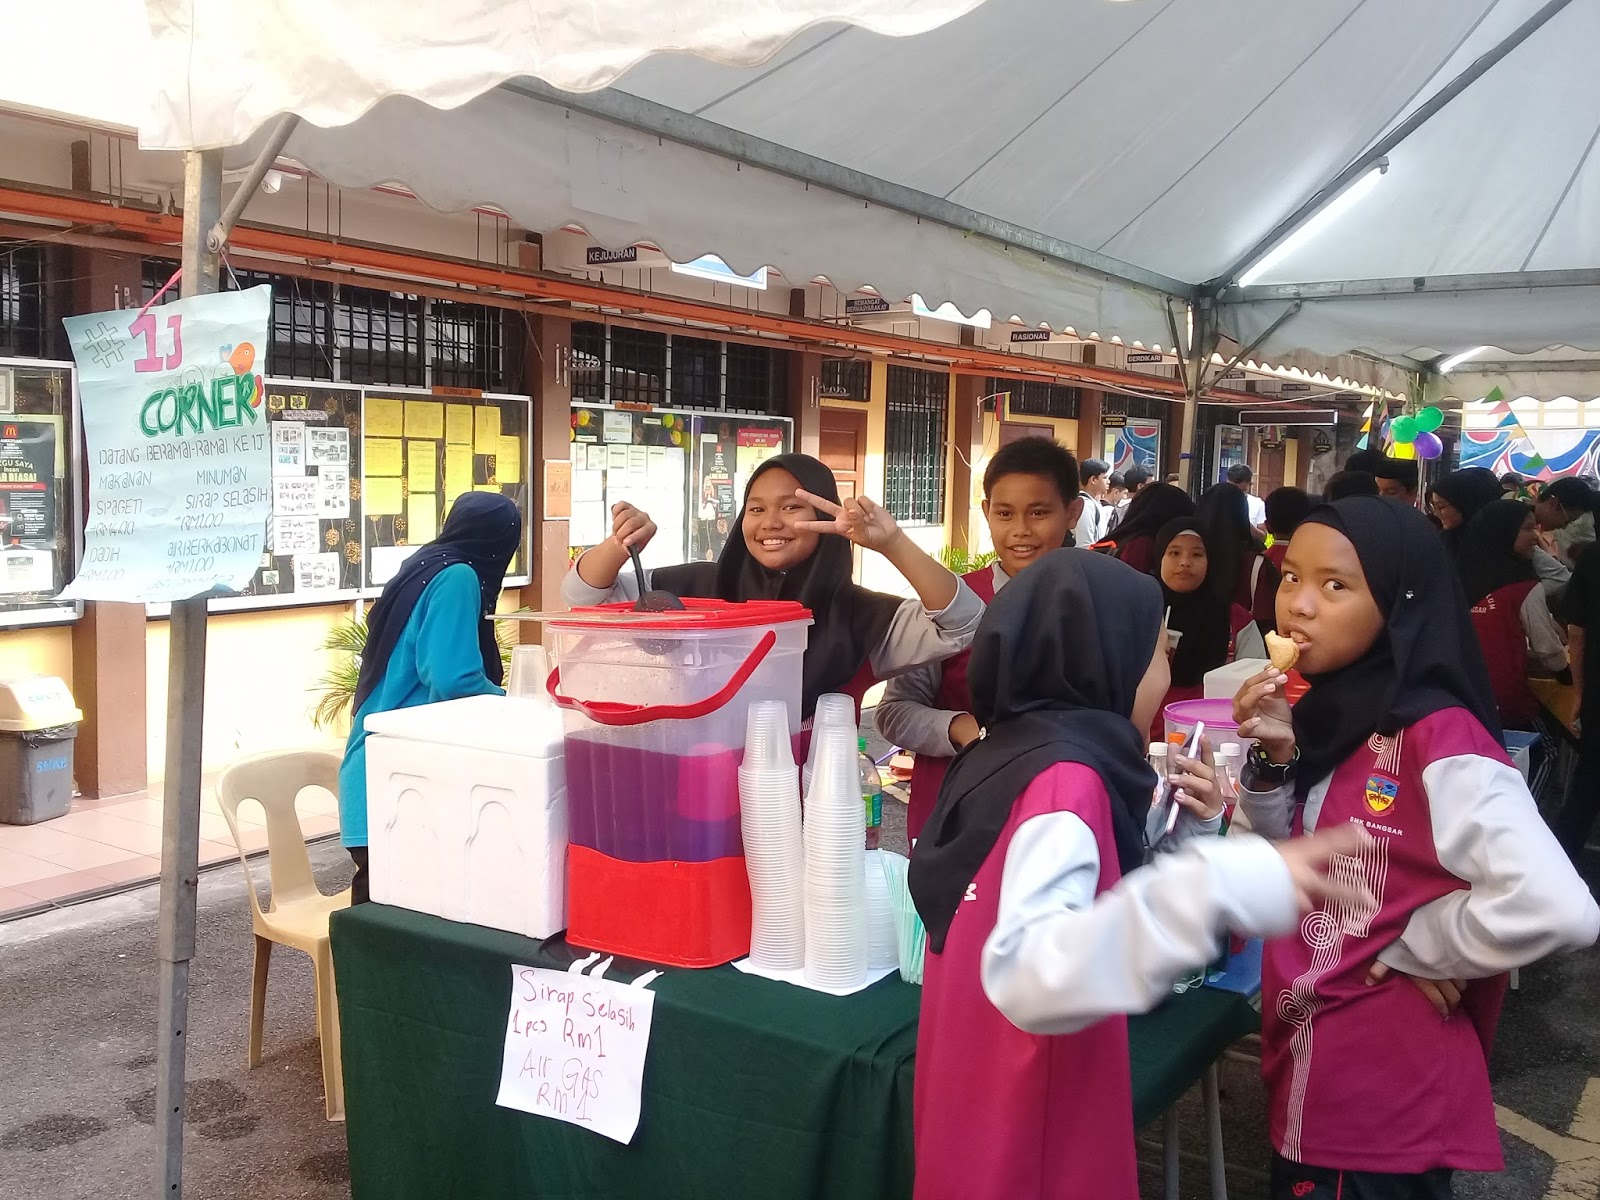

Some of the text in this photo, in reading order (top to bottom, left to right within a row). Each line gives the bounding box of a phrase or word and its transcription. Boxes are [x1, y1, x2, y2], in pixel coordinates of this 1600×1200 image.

[588, 247, 635, 262] KEJUJURAN
[1012, 332, 1048, 341] RASIONAL
[1128, 354, 1162, 363] BERDIKARI
[139, 371, 259, 437] CORNER
[233, 435, 249, 451] KE
[15, 459, 34, 470] SAYA
[8, 472, 37, 483] BIASA!
[1349, 816, 1403, 837] SMK BANGSAR
[519, 969, 575, 1017] Sirap
[561, 1057, 603, 1099] GAS
